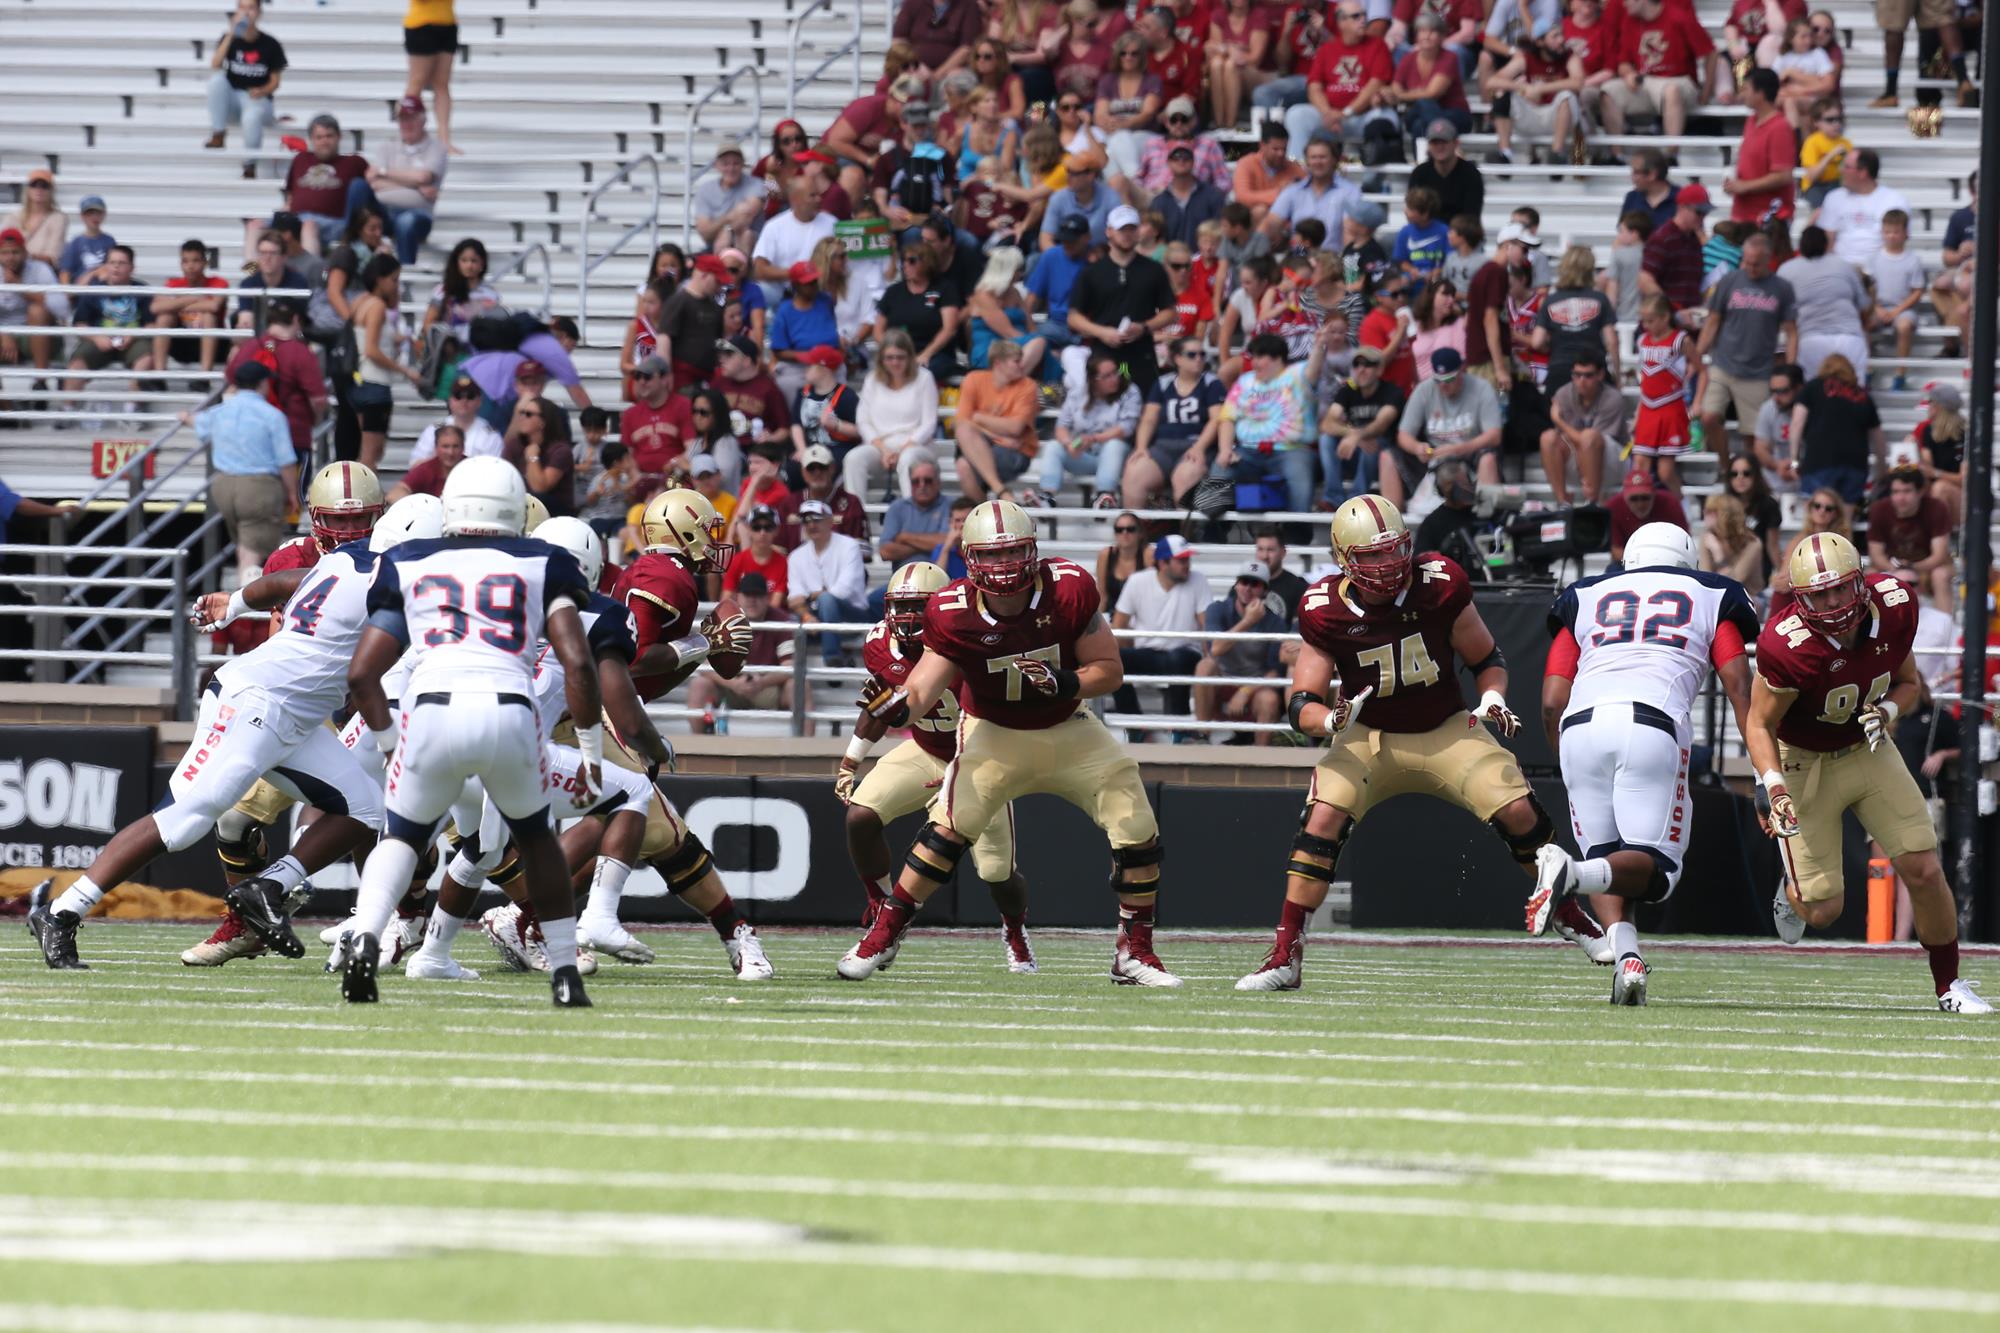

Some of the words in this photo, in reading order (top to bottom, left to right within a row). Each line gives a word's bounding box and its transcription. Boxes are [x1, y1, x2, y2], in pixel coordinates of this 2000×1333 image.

[1167, 397, 1200, 424] 12
[101, 441, 150, 475] EX
[1418, 560, 1451, 584] 74
[291, 570, 340, 637] 4
[938, 584, 968, 612] 77
[1303, 582, 1330, 611] 74
[1873, 578, 1910, 608] 84
[413, 572, 528, 657] 39
[1591, 590, 1694, 651] 92
[1774, 614, 1813, 649] 84
[1356, 632, 1440, 698] 74
[183, 704, 236, 782] BISON
[1669, 748, 1690, 843] BISON
[0, 842, 43, 867] CE
[52, 844, 104, 868] 189
